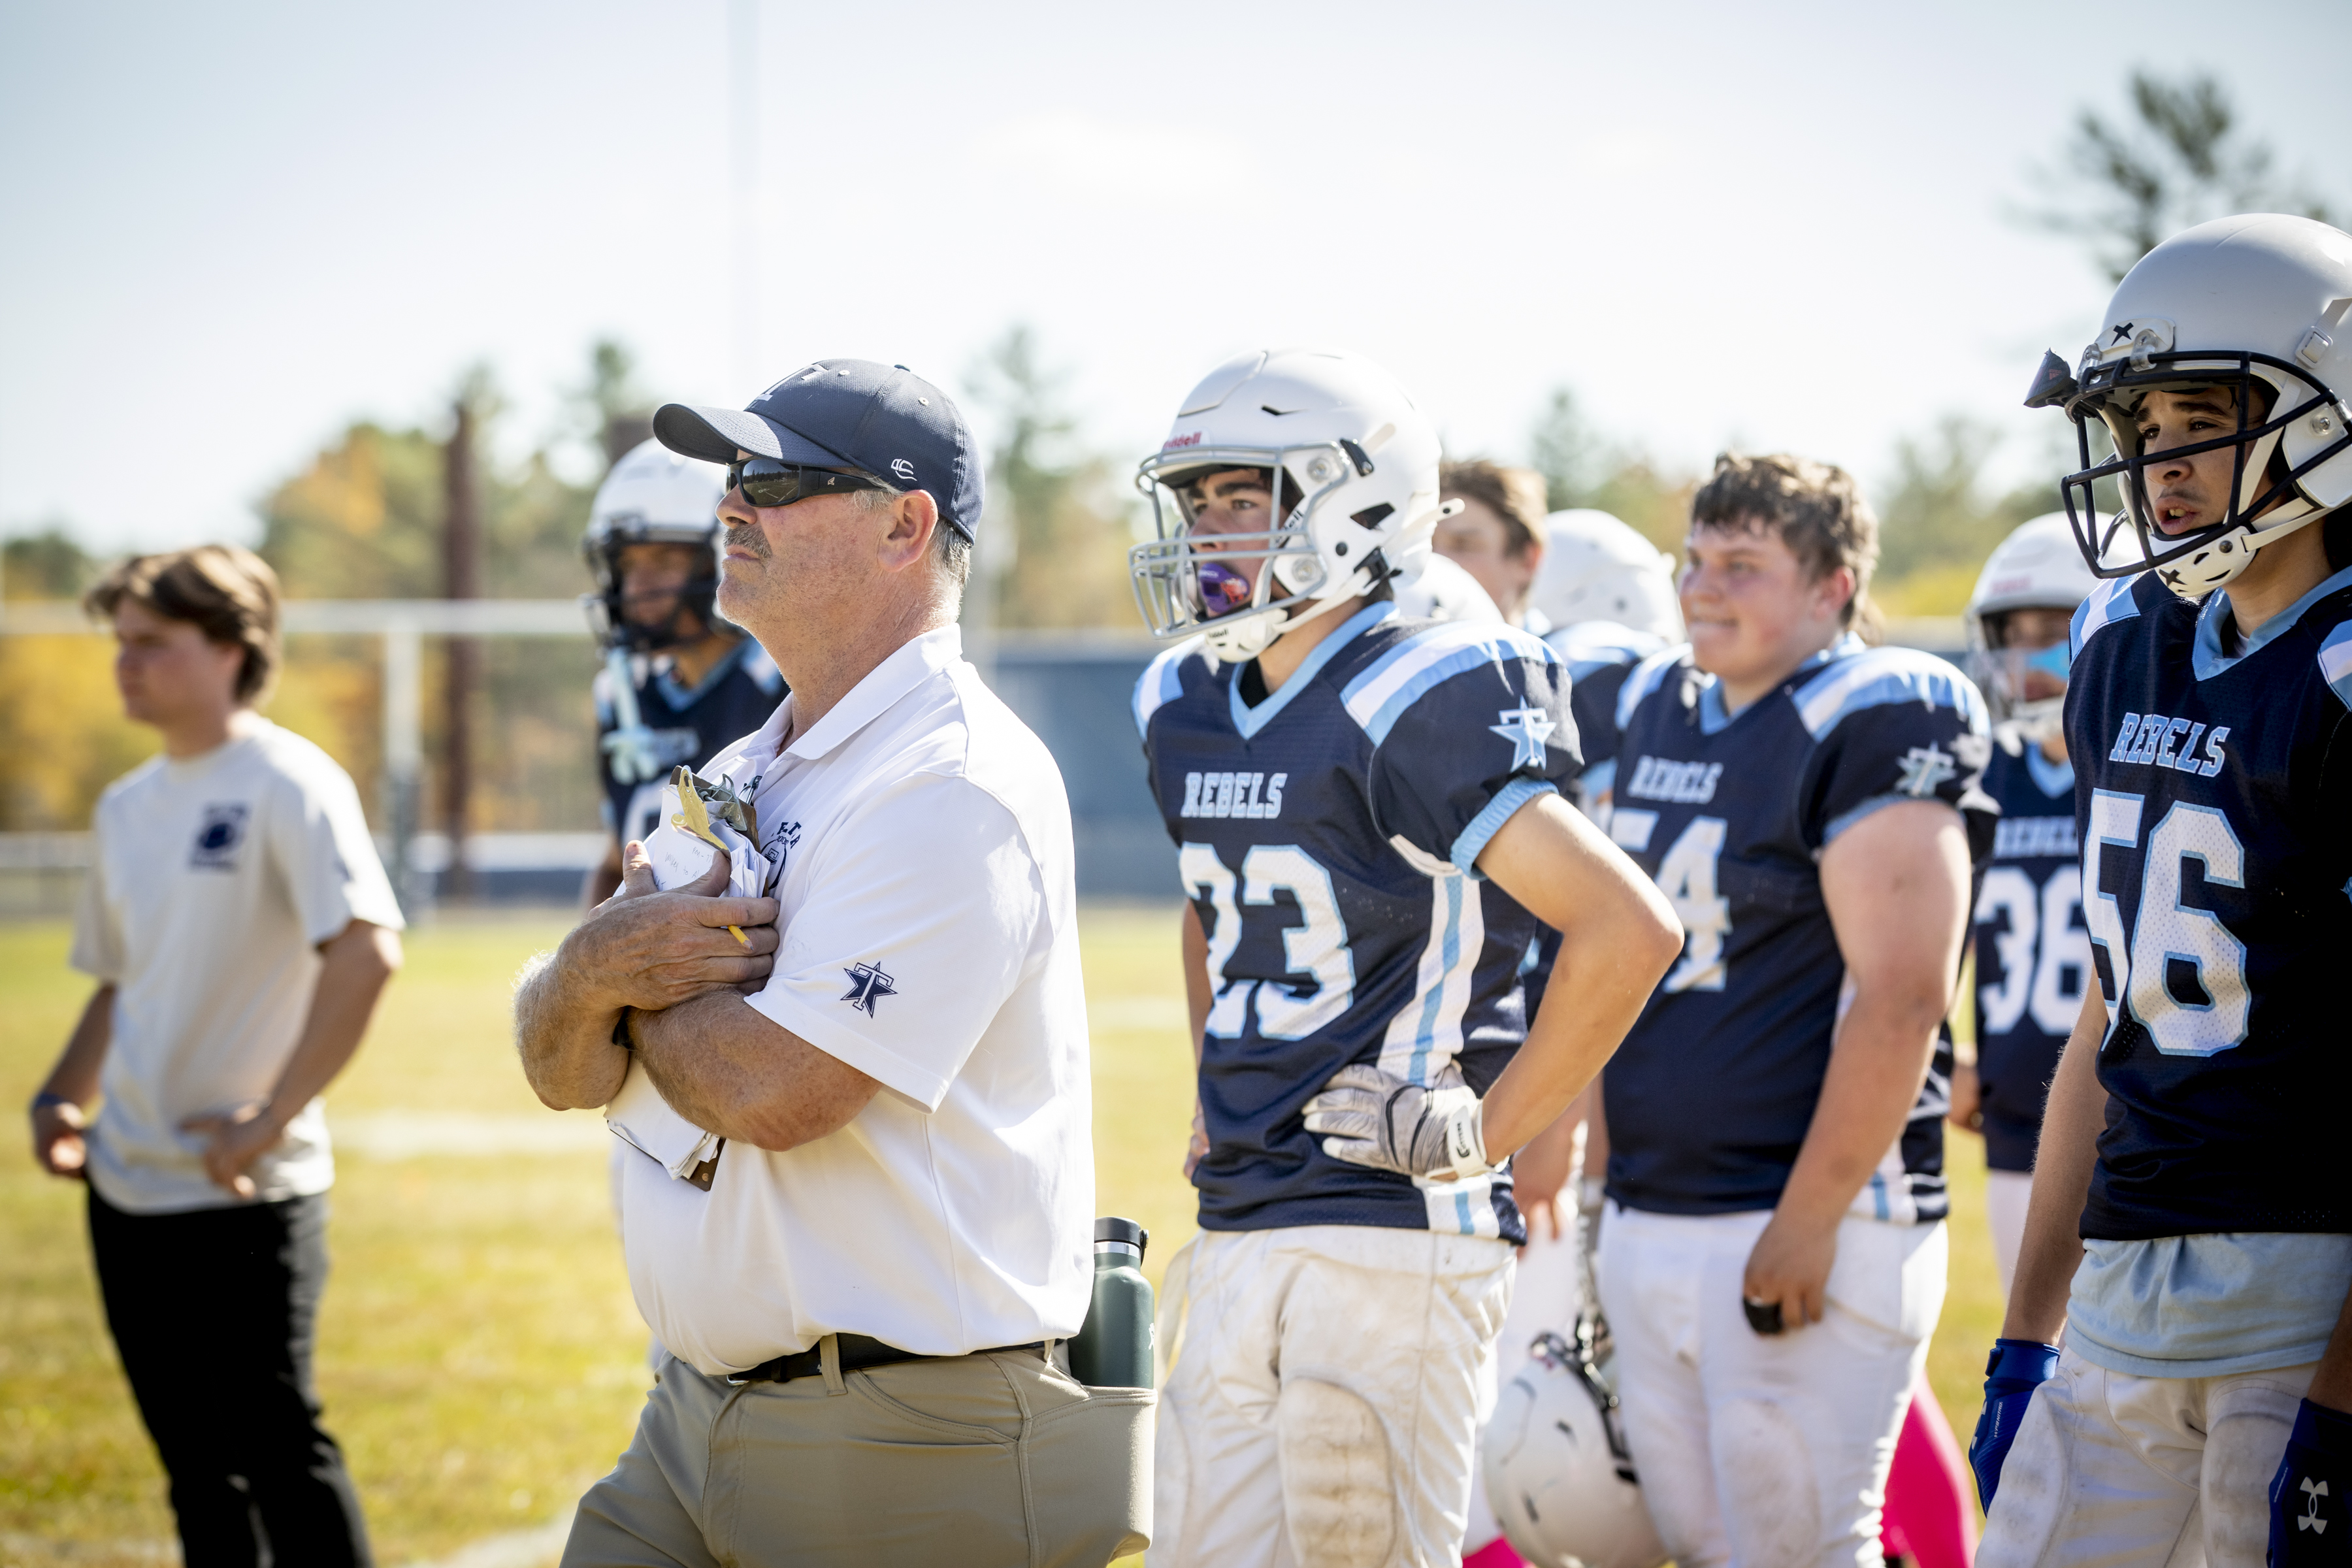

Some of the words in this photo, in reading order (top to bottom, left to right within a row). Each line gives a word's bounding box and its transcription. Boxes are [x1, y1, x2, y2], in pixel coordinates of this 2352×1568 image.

[1180, 772, 1288, 819] REBELS
[2108, 711, 2231, 777] REBELS
[1993, 816, 2079, 860] REBEL
[1179, 841, 1357, 1041] 23
[1974, 864, 2085, 1036] 36
[2082, 788, 2252, 1058] 56
